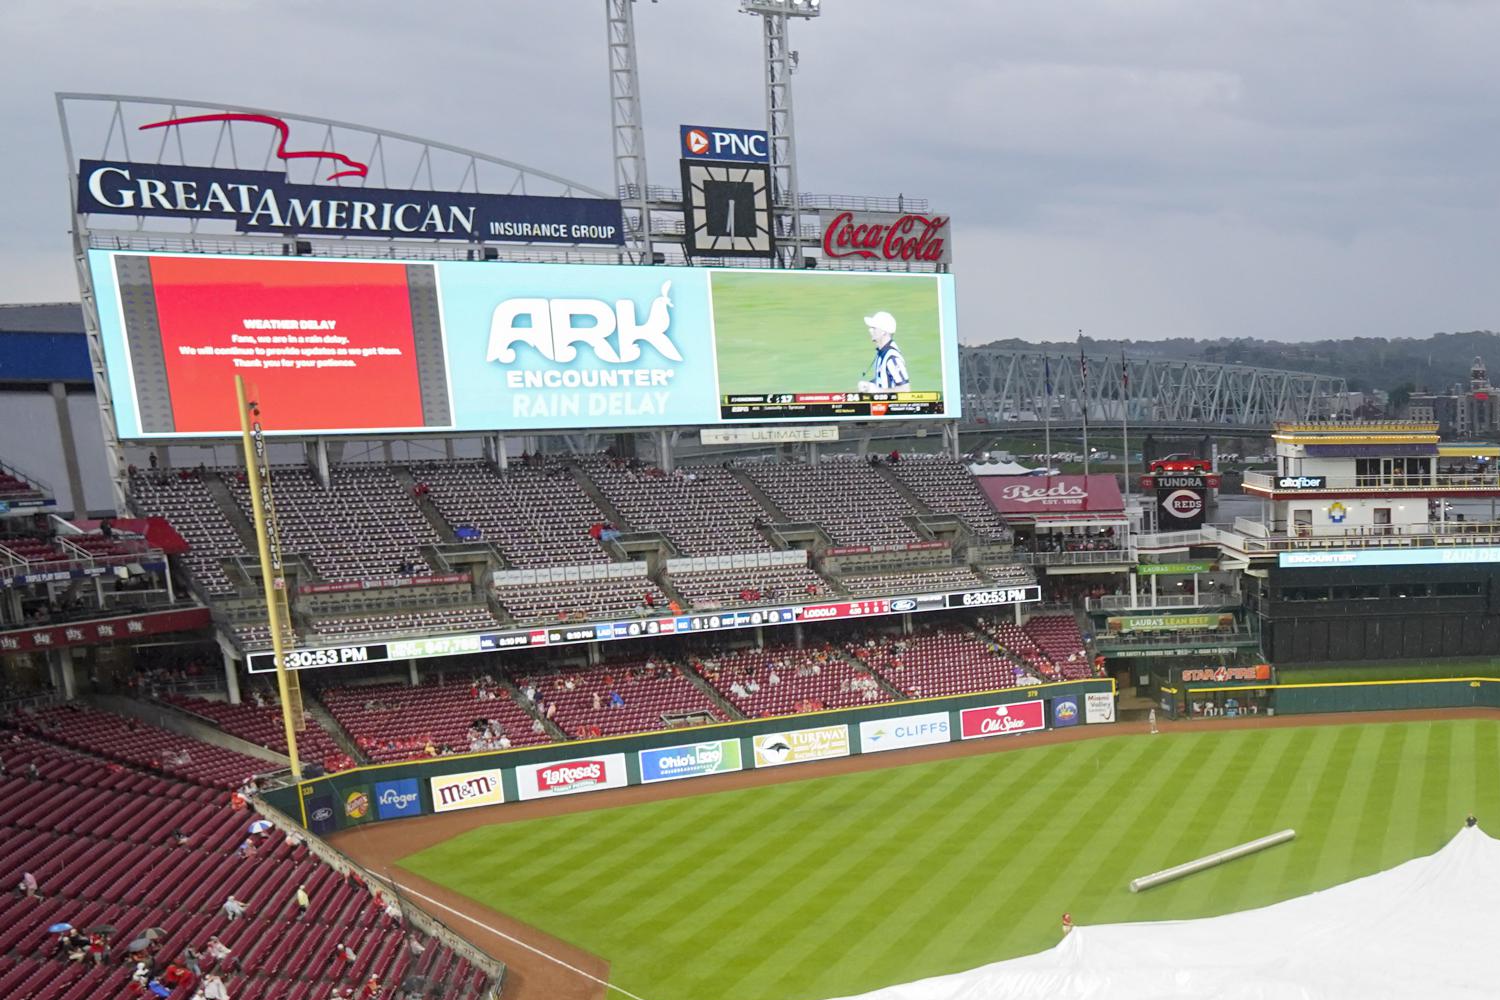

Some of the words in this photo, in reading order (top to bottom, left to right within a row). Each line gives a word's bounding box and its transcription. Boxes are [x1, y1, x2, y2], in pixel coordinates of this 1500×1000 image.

[712, 131, 767, 158] PNC
[88, 166, 260, 216] GREAT
[250, 188, 477, 235] AMERICAN
[490, 220, 568, 238] INSURANCE
[571, 223, 616, 240] GROUP
[823, 211, 950, 263] Coca-Cola
[243, 319, 299, 330] WEATHER
[299, 320, 336, 330] DELAY
[486, 280, 683, 363] ARK
[507, 368, 669, 388] ENCOUNTER
[513, 393, 586, 418] RAIN
[591, 390, 671, 416] DELAY
[751, 429, 813, 441] ULTIMATE
[815, 429, 836, 439] JET
[1158, 477, 1203, 487] TUNDRA
[1002, 482, 1088, 503] Reds
[1174, 499, 1202, 509] REDS
[1442, 550, 1476, 562] RAIN
[963, 591, 1006, 606] 6:30:53
[1007, 589, 1026, 602] PM
[752, 613, 762, 625] 0
[769, 611, 780, 624] 0
[804, 607, 837, 618] LODOLO
[614, 627, 627, 635] TEX
[629, 624, 641, 636] 0
[647, 622, 660, 634] 3
[678, 621, 689, 630] KC
[693, 618, 700, 630] 1
[710, 616, 721, 629] 0
[1130, 618, 1164, 627] LAURA'S
[1164, 617, 1188, 626] LEAN
[1189, 616, 1209, 625] BEEF
[515, 636, 527, 645] PM
[581, 630, 593, 640] PM
[341, 647, 368, 663] PM
[1182, 669, 1215, 682] STAR
[1227, 667, 1257, 680] FIRE
[895, 721, 949, 738] CLIFFS
[981, 718, 1000, 734] Old
[999, 715, 1026, 732] Spice
[791, 728, 847, 745] TURFWAY
[658, 754, 696, 770] Ohio's
[542, 762, 601, 785] LaRosa's
[380, 789, 419, 810] Kroger
[314, 809, 331, 819] Ford
